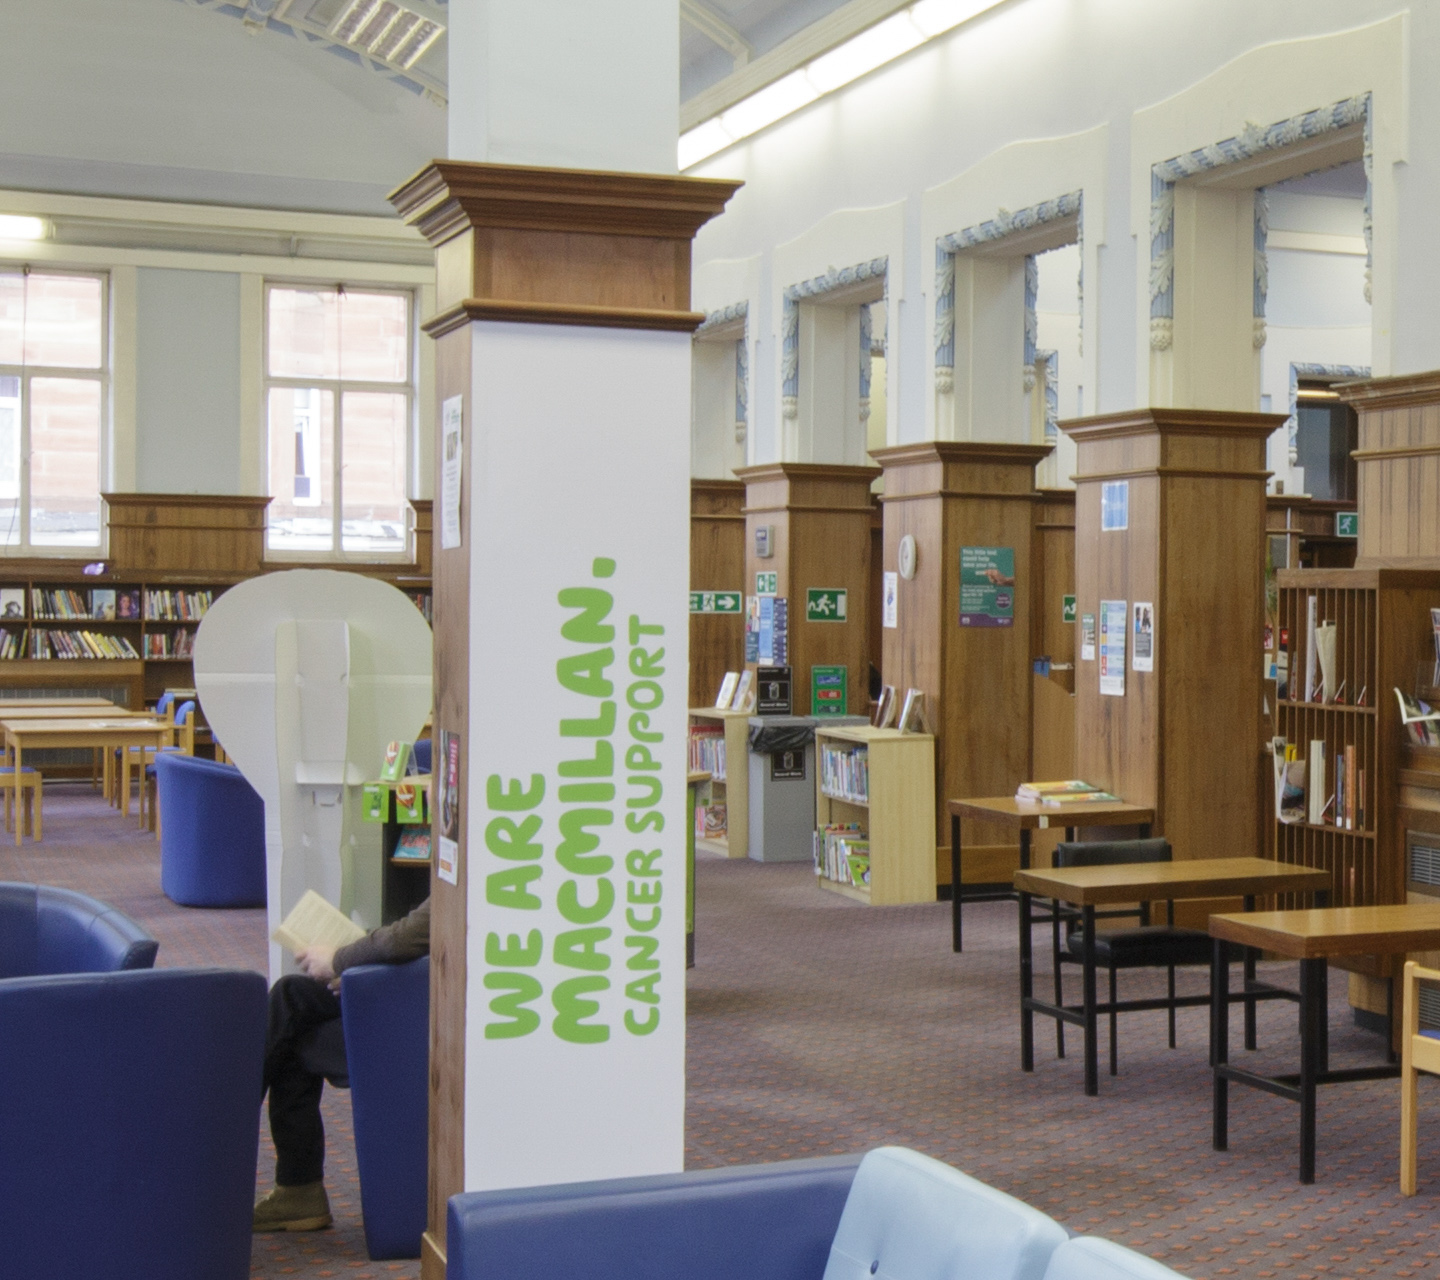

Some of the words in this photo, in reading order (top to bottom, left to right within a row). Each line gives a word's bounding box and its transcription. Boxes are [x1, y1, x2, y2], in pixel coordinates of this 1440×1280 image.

[551, 557, 616, 1044] MACMILLAN.
[625, 614, 665, 833] SUPPORT
[484, 772, 546, 910] ARE
[482, 928, 543, 1040] WE
[623, 849, 663, 1036] CANCER
